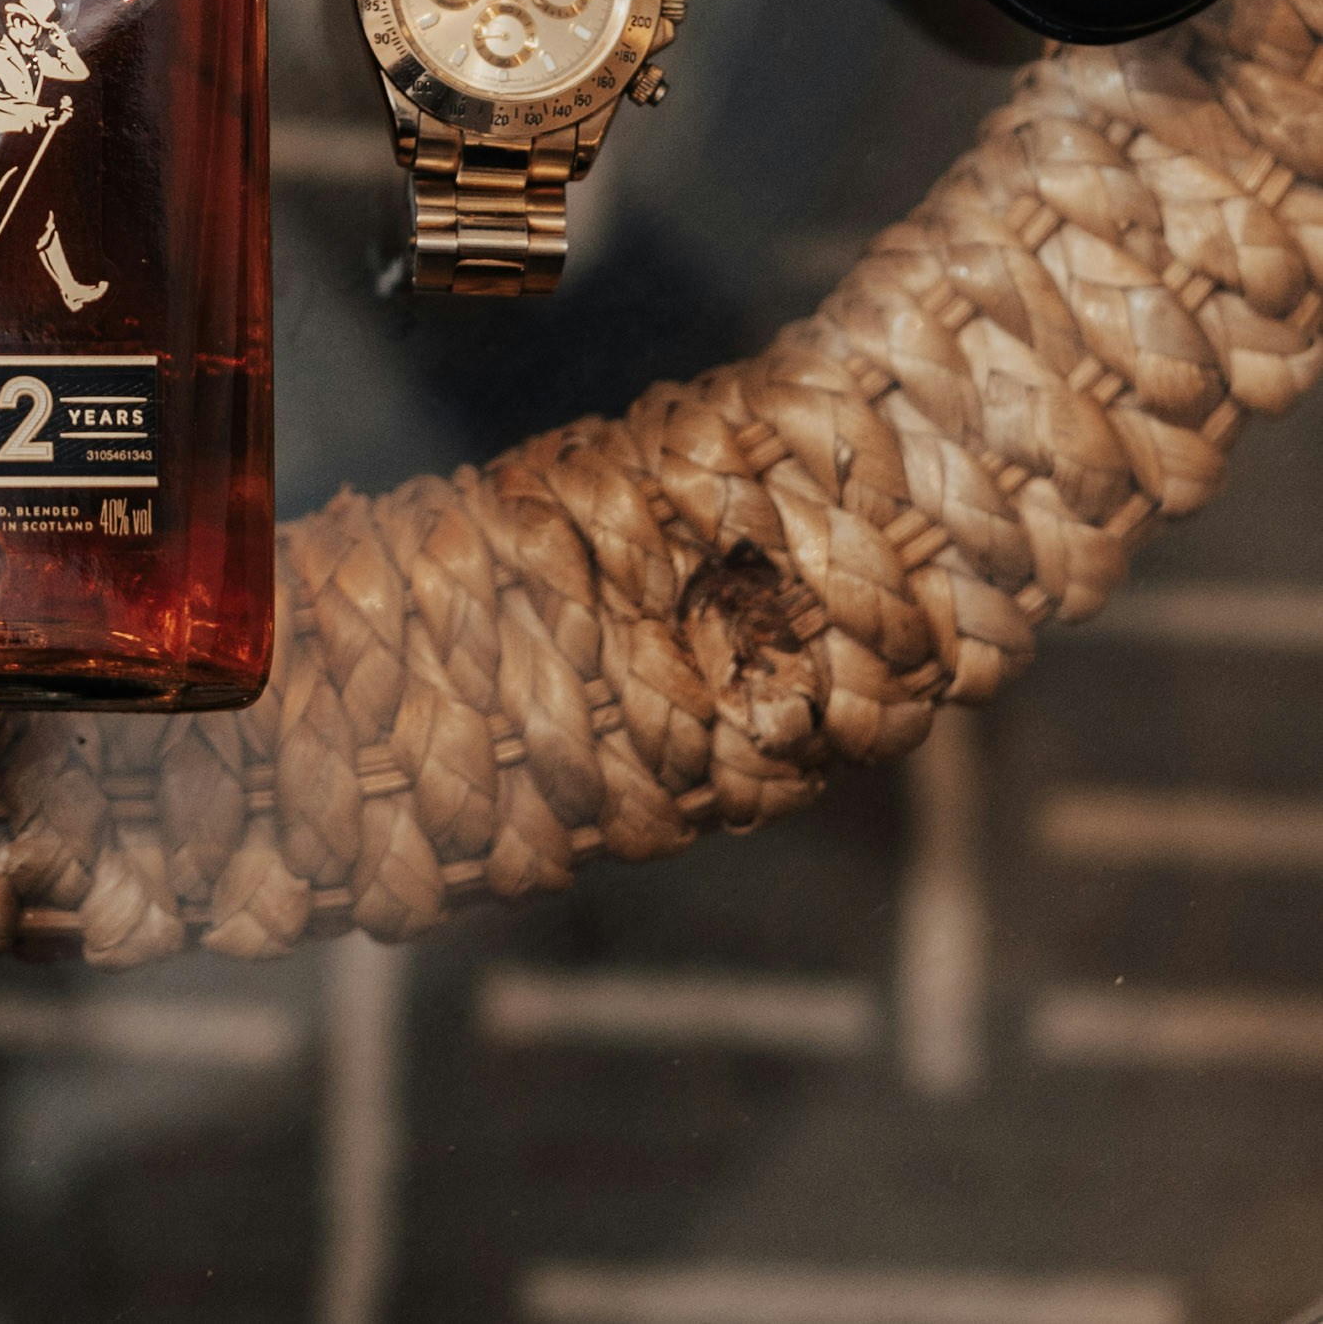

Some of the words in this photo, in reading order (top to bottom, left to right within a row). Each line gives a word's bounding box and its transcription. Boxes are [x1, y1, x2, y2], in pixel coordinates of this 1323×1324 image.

[630, 14, 652, 29] 200
[374, 32, 390, 45] 90
[596, 75, 616, 89] 160
[573, 93, 593, 107] 150
[552, 104, 573, 118] 140
[523, 111, 544, 126] 130
[67, 409, 145, 426] YEARS
[86, 449, 153, 461] 3105461343
[16, 506, 79, 517] BLENDED
[99, 498, 130, 537] 40%
[133, 498, 153, 537] vol
[2, 521, 17, 531] IN
[22, 521, 94, 532] SCOTLAND
